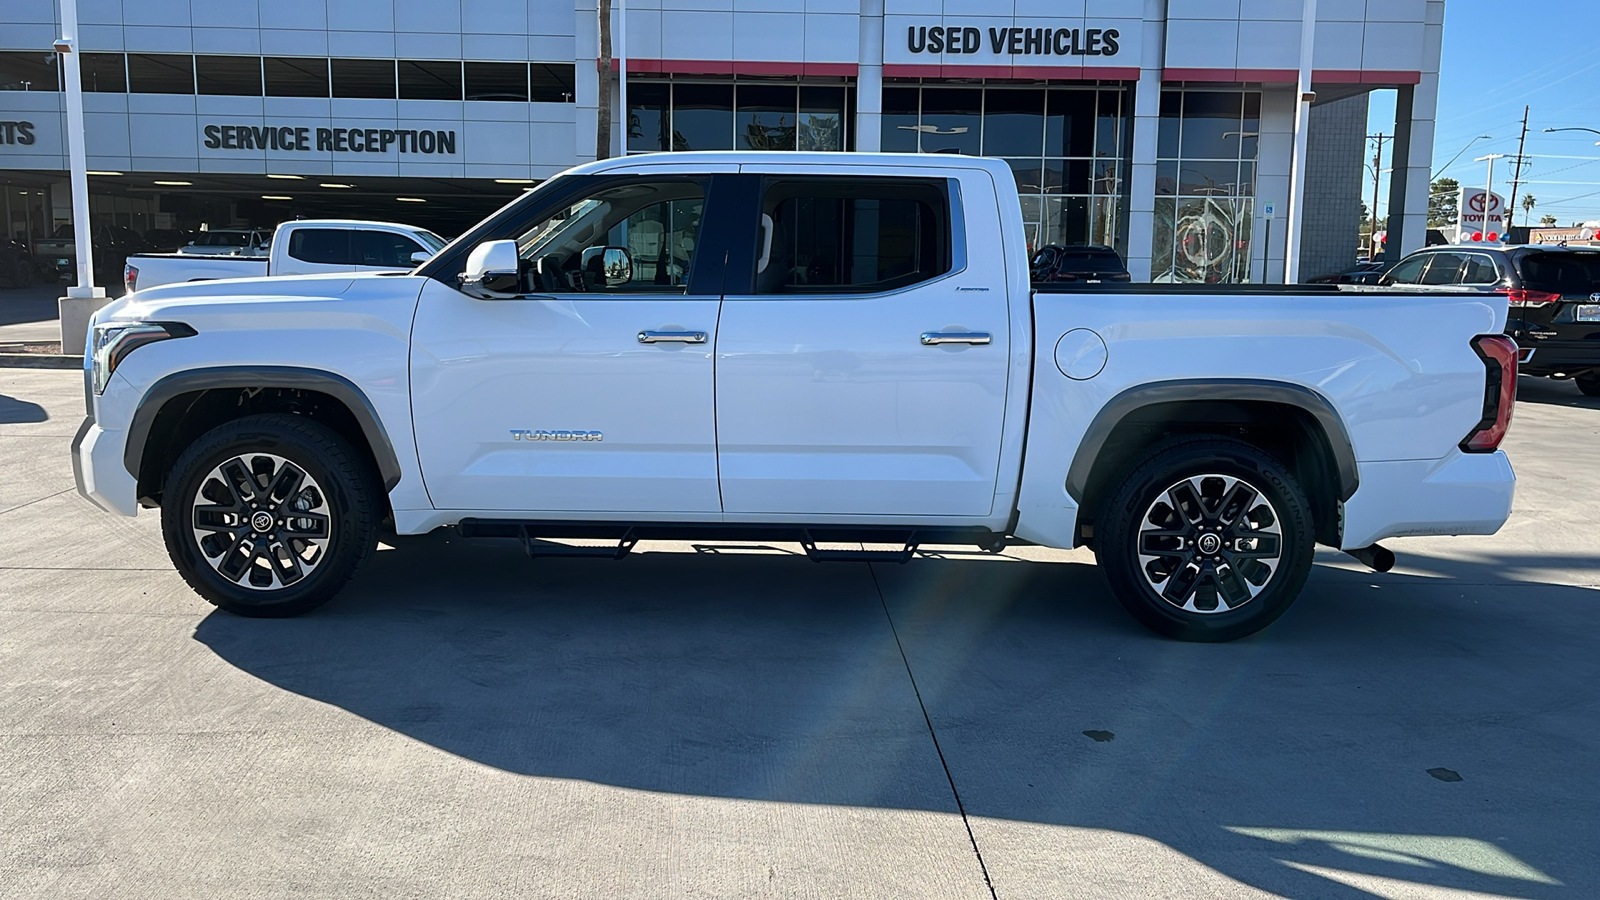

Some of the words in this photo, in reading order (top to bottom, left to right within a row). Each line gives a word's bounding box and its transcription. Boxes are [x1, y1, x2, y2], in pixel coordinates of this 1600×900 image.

[908, 26, 981, 54] USED
[988, 27, 1120, 56] VEHICLES
[203, 124, 311, 151] SERVICE
[316, 127, 456, 155] RECEPTION
[1462, 214, 1502, 223] TOYTA
[509, 429, 604, 442] TUNDRA
